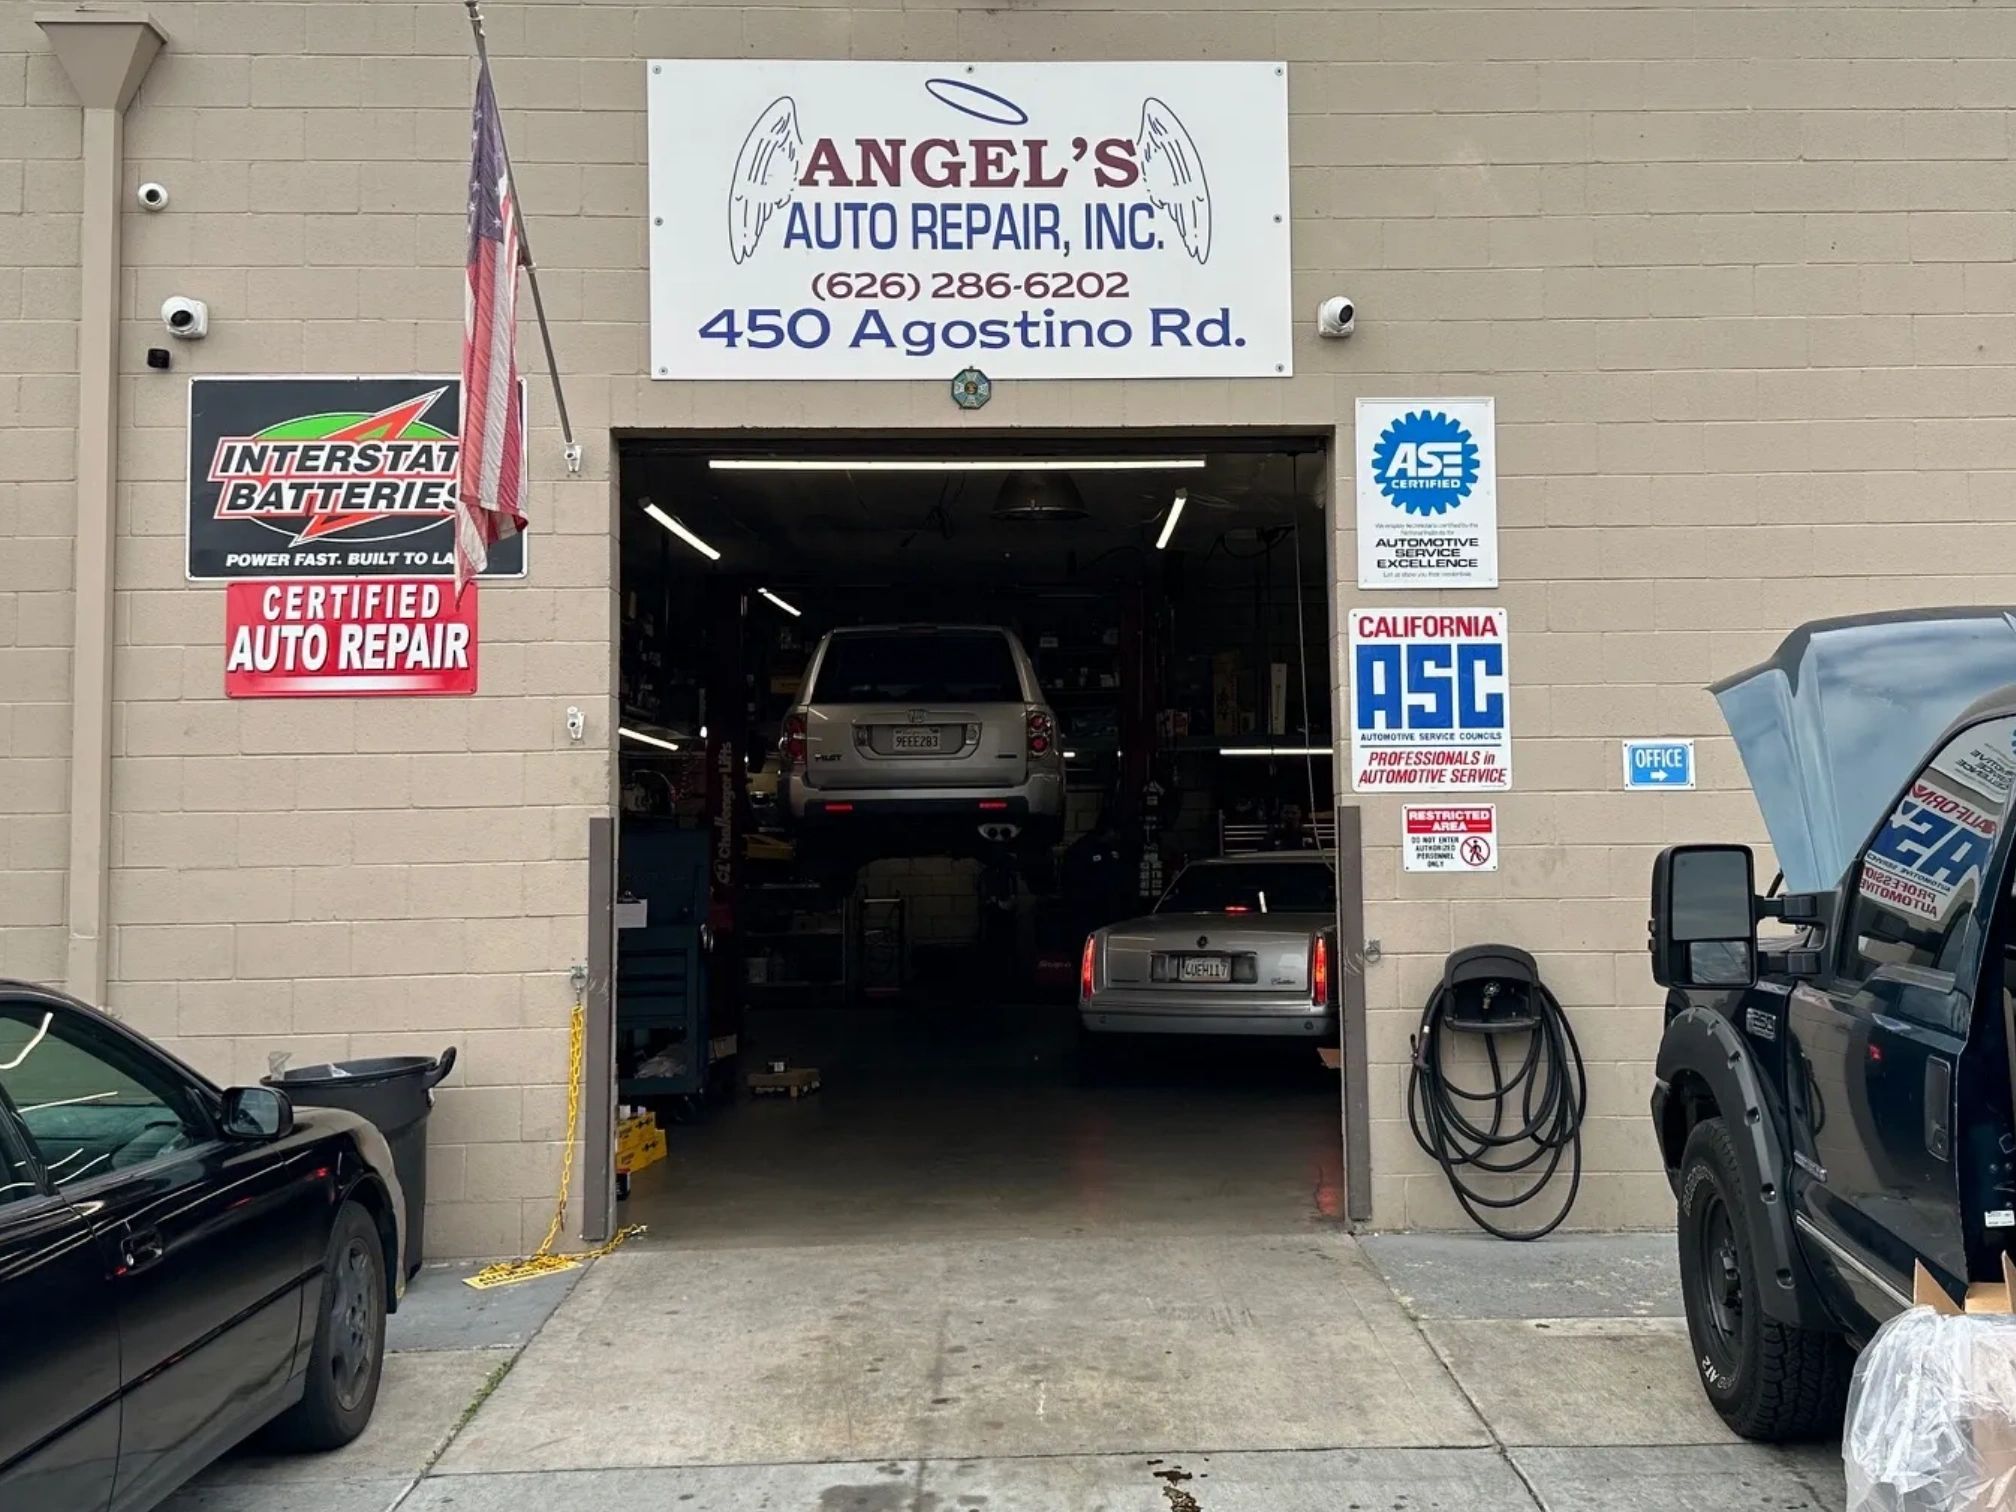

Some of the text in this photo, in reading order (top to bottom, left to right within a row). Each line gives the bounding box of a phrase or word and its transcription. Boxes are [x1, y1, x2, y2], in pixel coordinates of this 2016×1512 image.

[801, 136, 1139, 188] ANGEL'S
[783, 202, 1164, 257] AUTO REPAIR, INC.
[811, 272, 1130, 301] (626) 286-6202
[699, 307, 1246, 356] 450 Agostino Rd.
[218, 443, 460, 474] INTERSTAT
[1385, 442, 1463, 478] ASE
[1391, 479, 1461, 489] CERTIFIED
[1375, 537, 1479, 548] AUTOMOTIVE
[226, 551, 455, 567] POWER FAST. BUILT TO LA
[1395, 548, 1461, 558] SERVICE
[1376, 558, 1479, 569] EXCELLENCE
[262, 584, 441, 621] CERTIFIED
[1359, 615, 1498, 638] CALIFORNIA
[227, 622, 471, 672] AUTO REPAIR
[1356, 643, 1504, 729] ASC
[1360, 731, 1502, 742] AUTOMOTIVE SERVICE COUNCILS
[1368, 751, 1496, 766] PROFESSIONALS in
[1635, 748, 1683, 768] OFFICE
[1359, 768, 1507, 785] AUTOMOTIVE SERVICE
[1408, 810, 1489, 821] RESTRICTED
[1432, 821, 1467, 832] AREA
[1411, 836, 1459, 844] DO NOT ENTER
[1415, 844, 1456, 852] AUTHORIZED
[1416, 852, 1455, 860] PERSONNEL
[1427, 860, 1444, 868] ONLY
